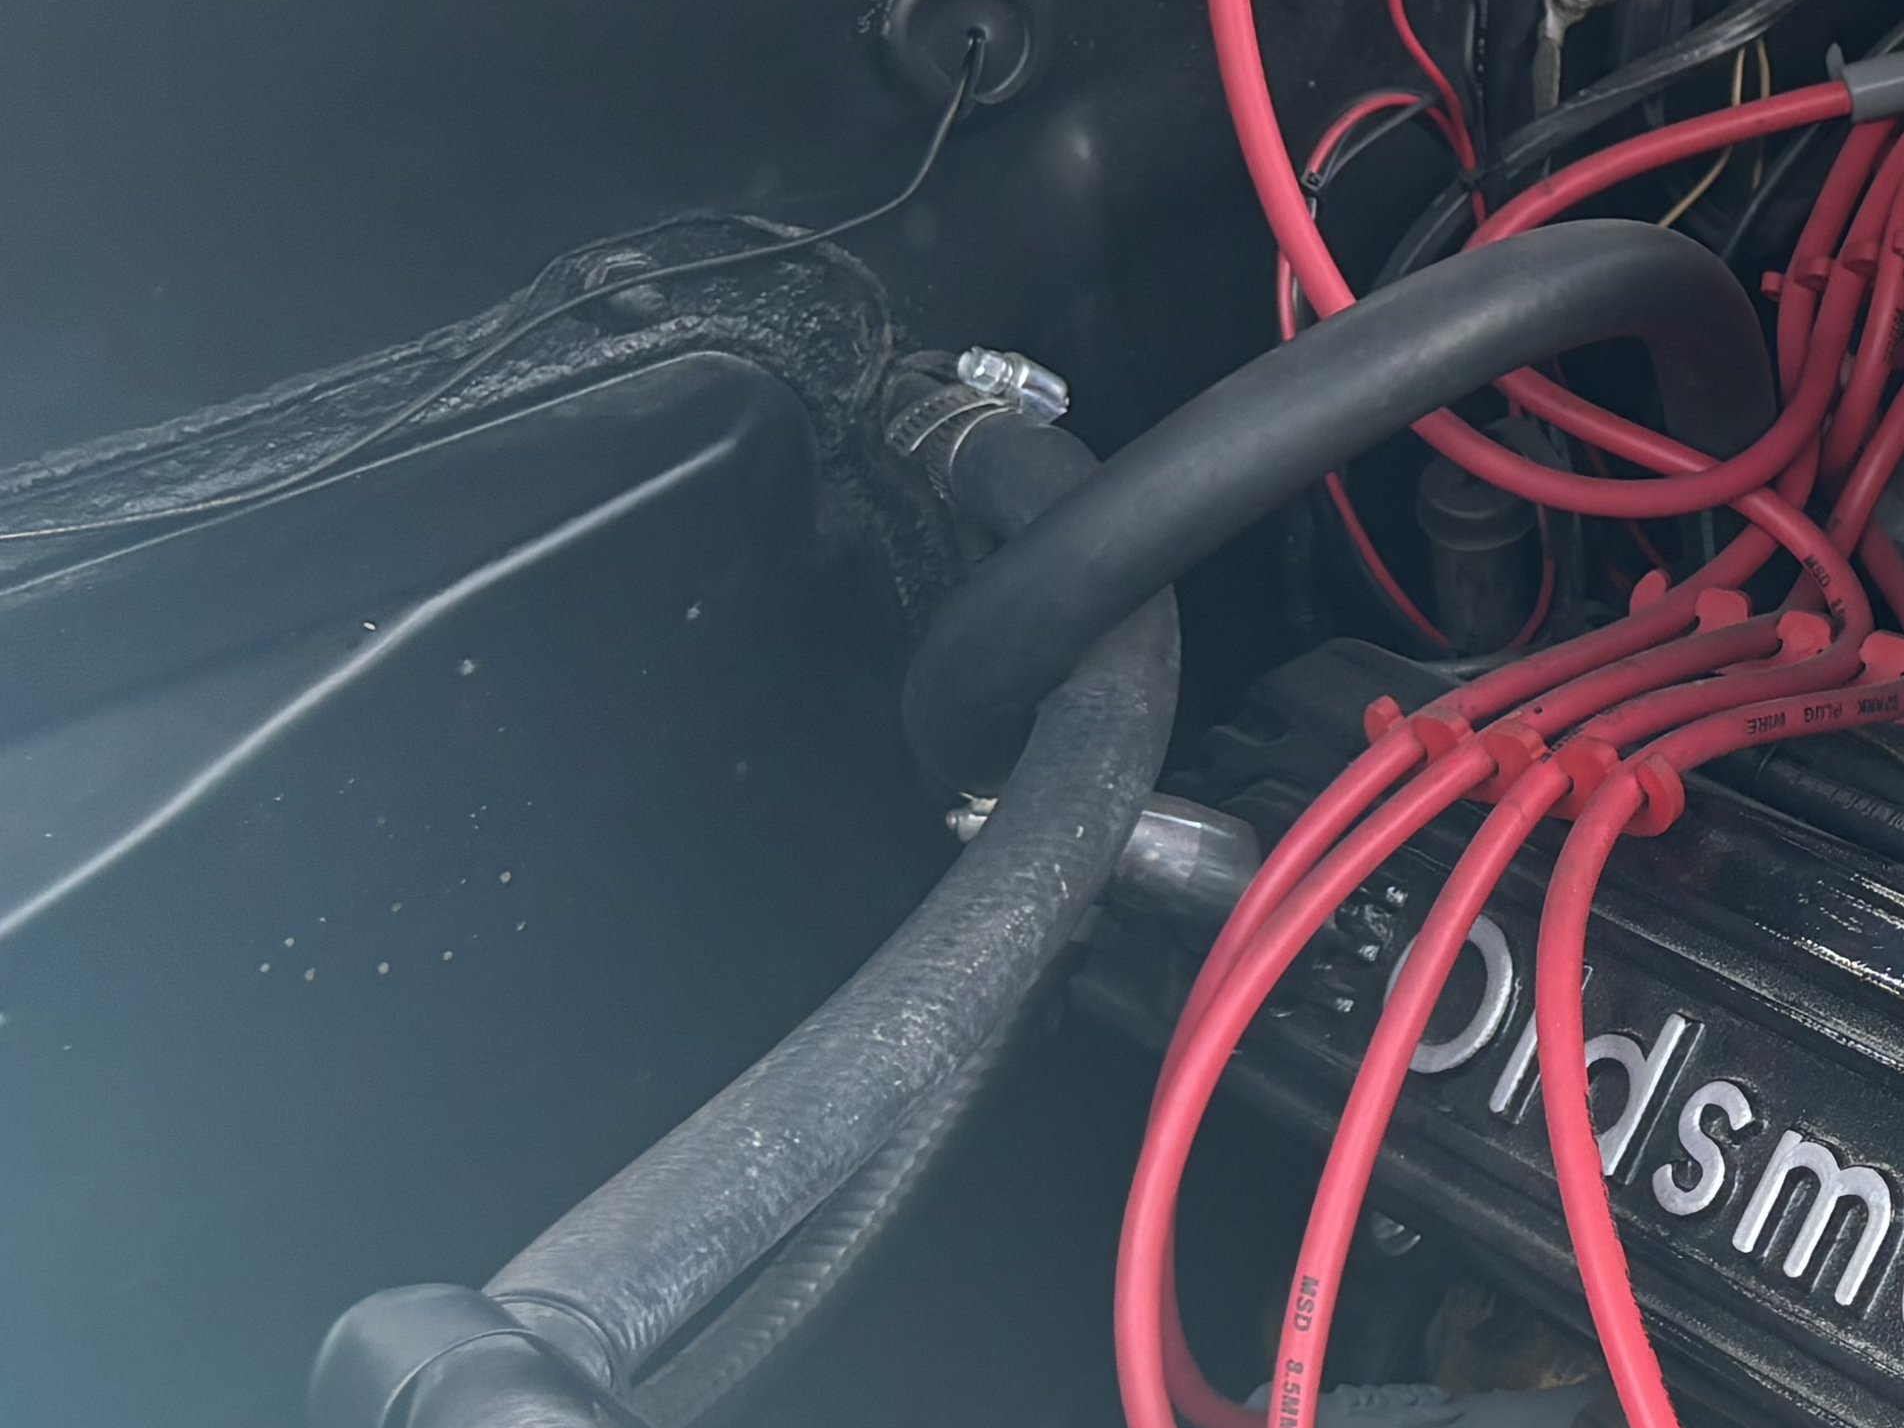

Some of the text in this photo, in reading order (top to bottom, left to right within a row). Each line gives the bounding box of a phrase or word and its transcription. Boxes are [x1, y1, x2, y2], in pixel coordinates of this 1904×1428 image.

[1746, 705, 1788, 737] WIRE
[1802, 698, 1844, 724] PLUG
[1293, 1274, 1321, 1334] MSD
